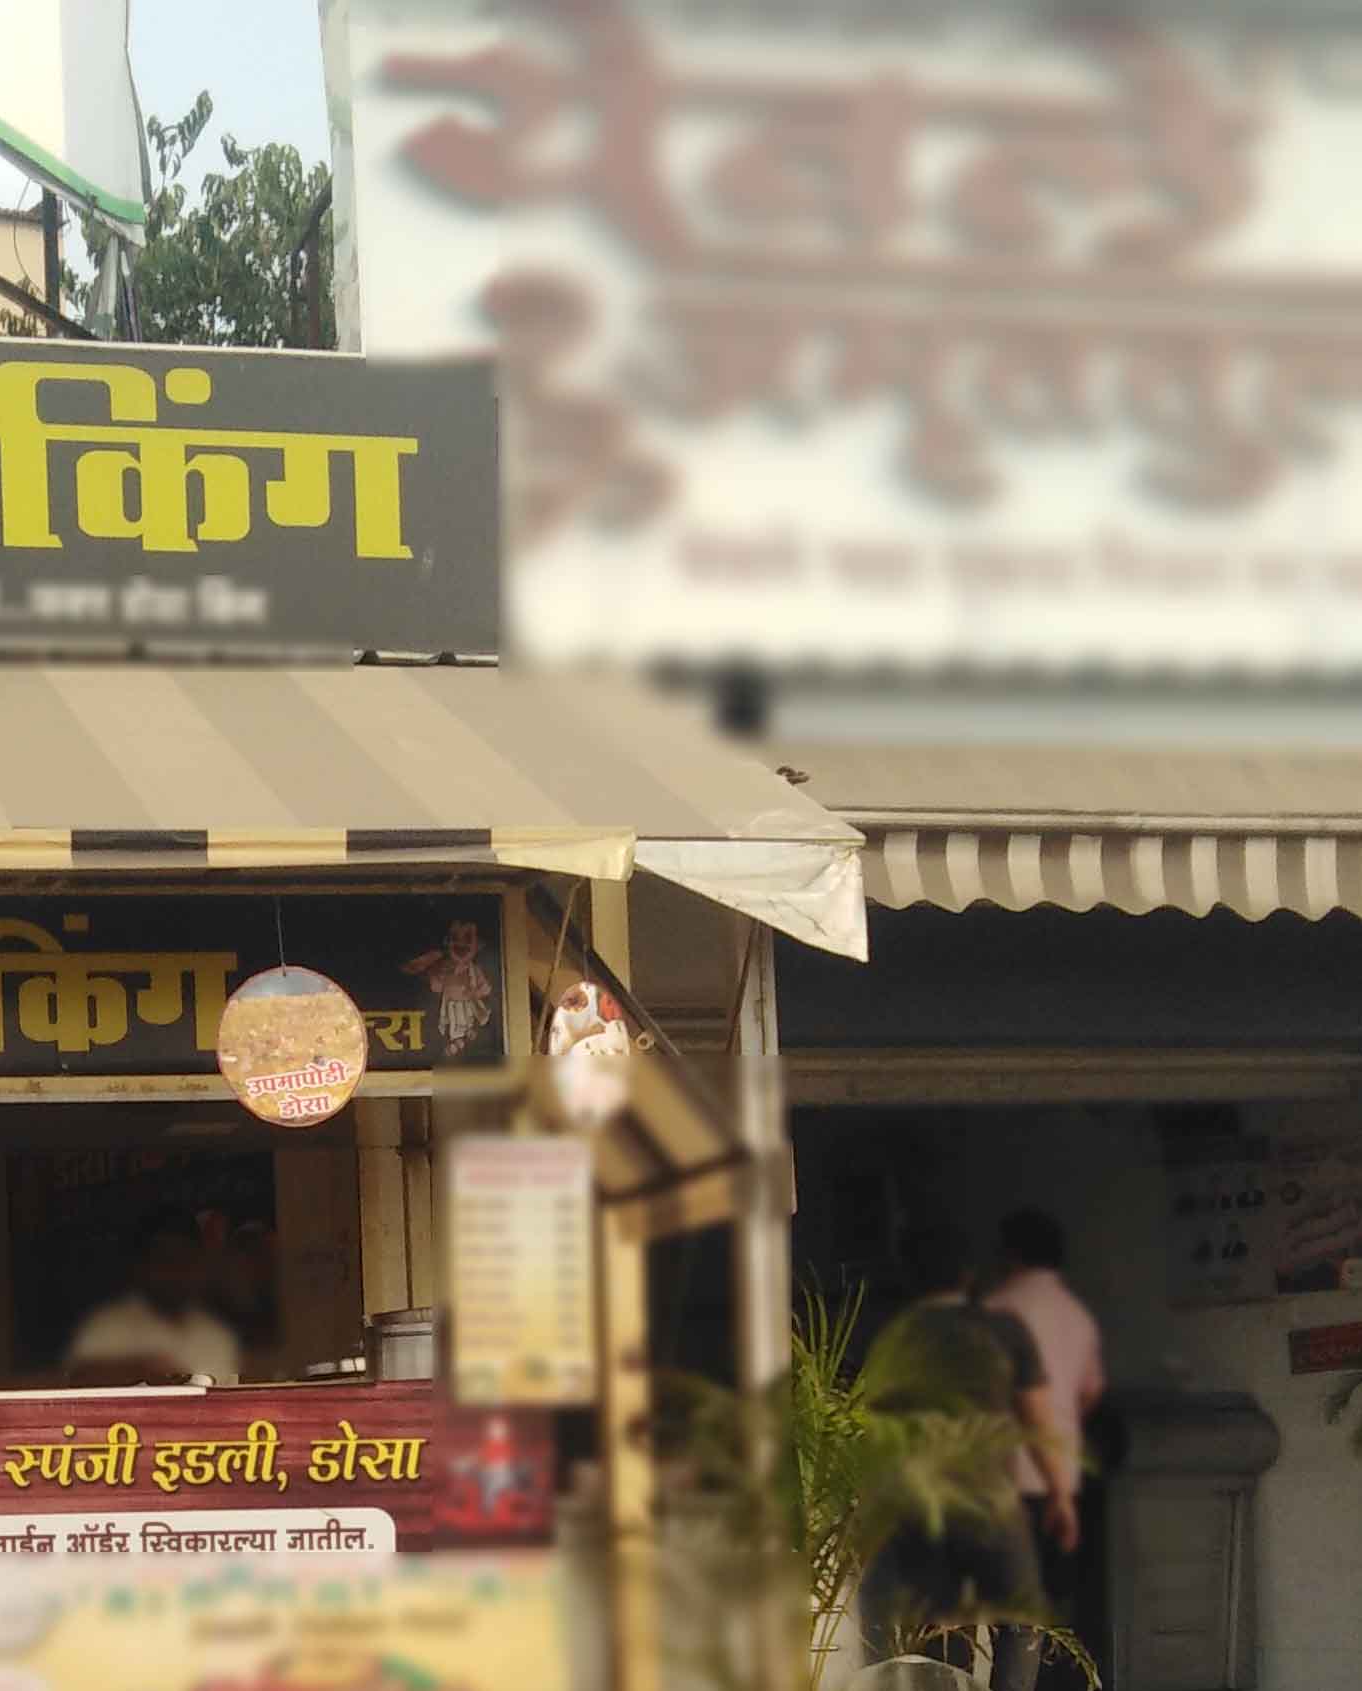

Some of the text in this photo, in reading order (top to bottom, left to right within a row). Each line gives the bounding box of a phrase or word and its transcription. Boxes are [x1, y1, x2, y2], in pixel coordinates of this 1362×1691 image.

[280, 1094, 331, 1117] डोसा
[4, 1423, 142, 1489] स्पंजी
[307, 1419, 428, 1483] डोसा
